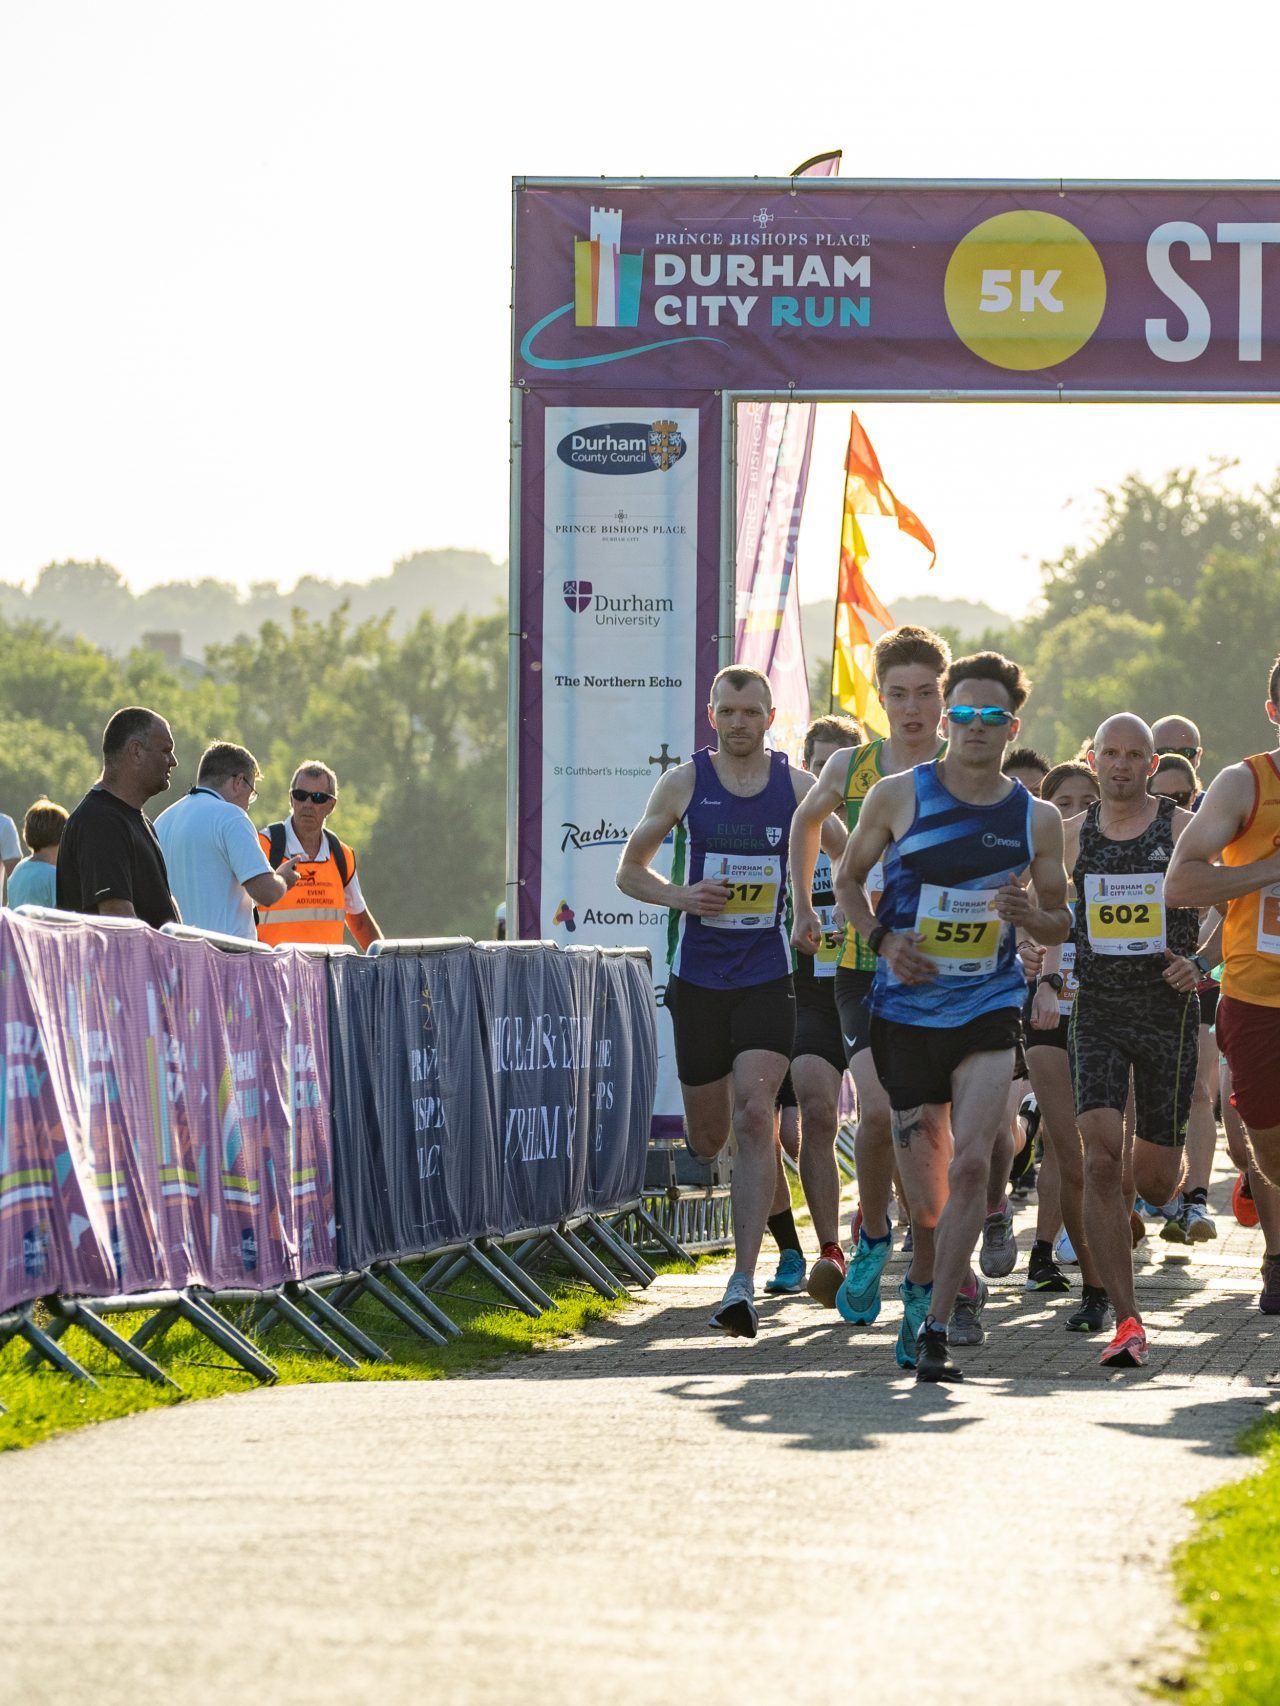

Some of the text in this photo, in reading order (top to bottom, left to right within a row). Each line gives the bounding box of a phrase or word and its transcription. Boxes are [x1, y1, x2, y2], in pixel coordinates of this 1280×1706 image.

[655, 233, 871, 247] PRINCE BISHOPS PLACE
[654, 255, 872, 287] DURHAM
[978, 269, 1064, 312] 5K
[654, 296, 871, 327] CITY RUN
[571, 435, 647, 451] Durham
[571, 452, 646, 465] County Council
[555, 525, 686, 535] PRINCE BISHOPS PLACE
[595, 594, 673, 612] Durham
[595, 613, 660, 628] University
[555, 676, 682, 688] The Northern Echo
[554, 766, 651, 778] St Cuthbert's Hospice
[561, 819, 631, 853] Radiss
[717, 824, 753, 836] ELVET
[706, 838, 765, 850] STRIDERS
[583, 909, 669, 926] Atom ban
[1099, 904, 1149, 925] 602
[935, 921, 988, 943] 557
